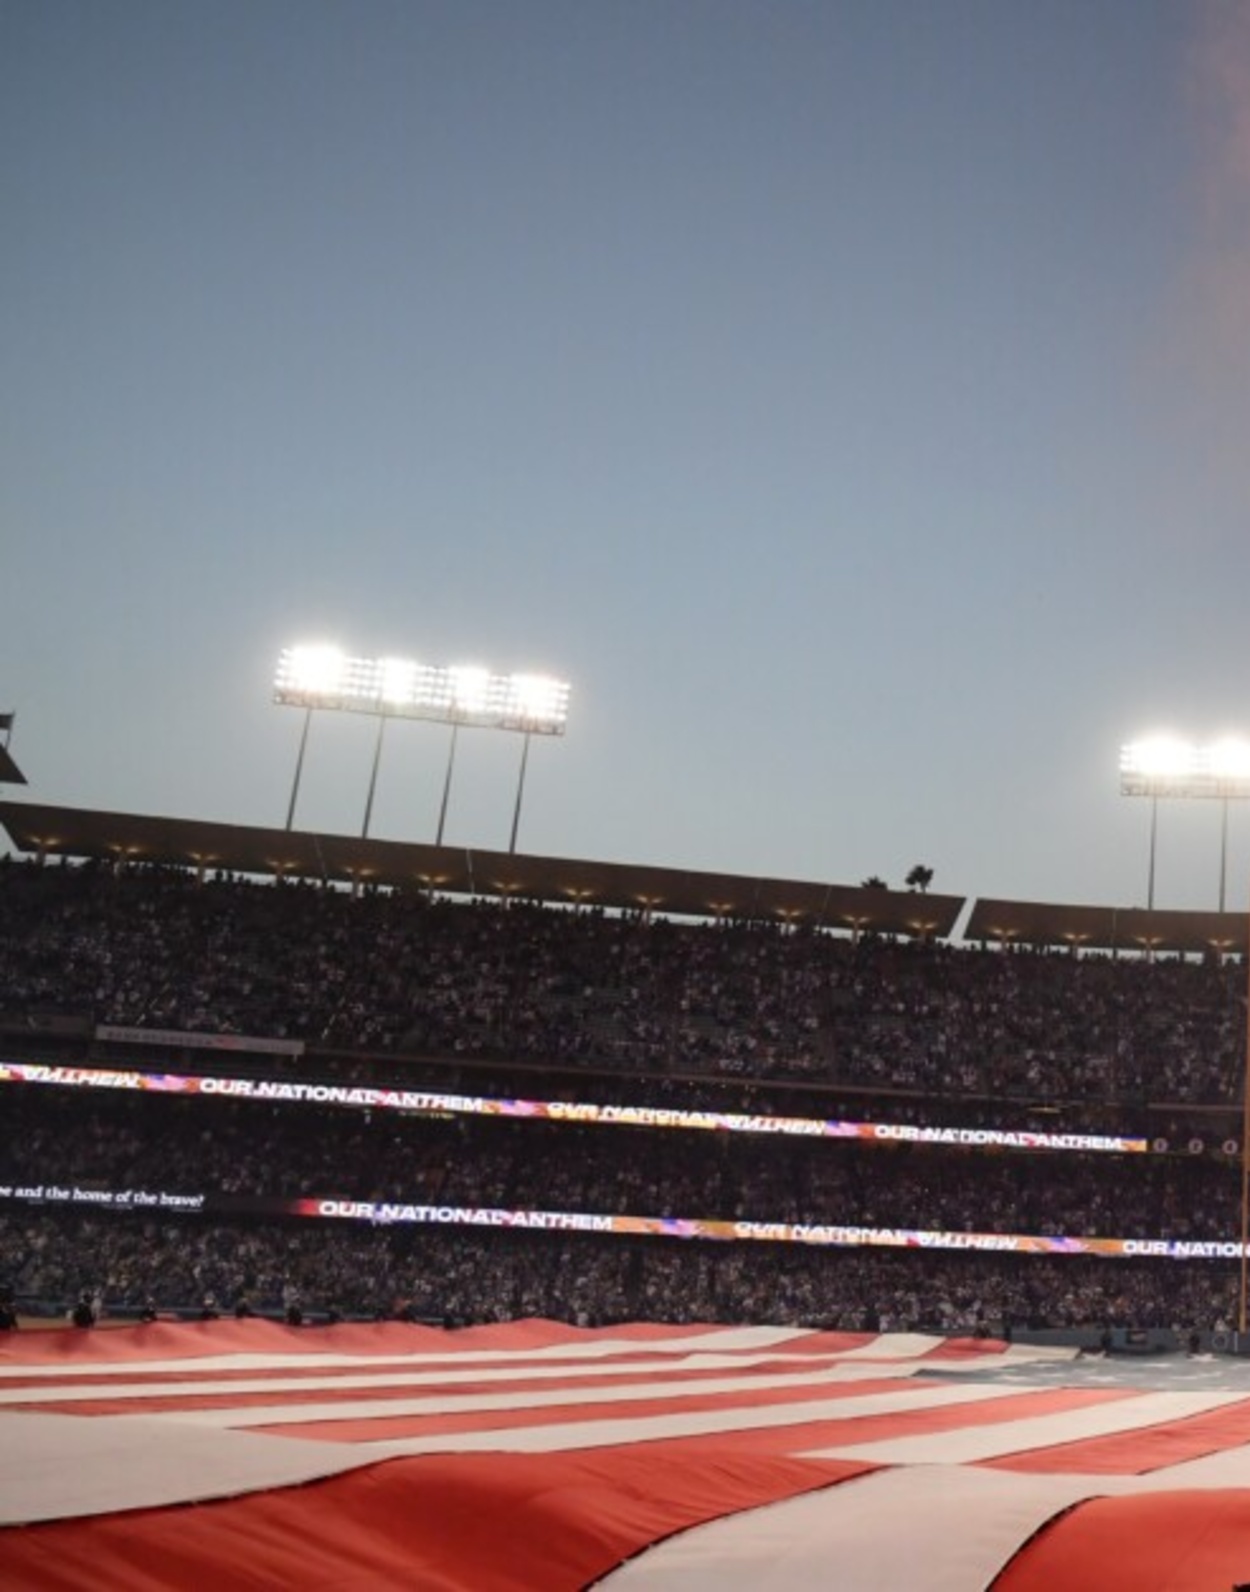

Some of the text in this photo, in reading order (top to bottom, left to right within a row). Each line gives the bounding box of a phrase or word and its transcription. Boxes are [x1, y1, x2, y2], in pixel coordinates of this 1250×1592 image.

[200, 1078, 483, 1111] OUR NATIONAL ANTHEM
[874, 1124, 920, 1140] OUR
[924, 1126, 1031, 1147] NATIONAL
[1034, 1133, 1123, 1150] ANTHEM
[15, 1186, 44, 1198] and
[46, 1187, 70, 1200] the
[73, 1188, 112, 1202] home
[116, 1190, 132, 1203] of
[134, 1191, 158, 1205] the
[319, 1200, 613, 1230] OUR NATIONAL ANTHEM
[1122, 1239, 1172, 1256] OUR
